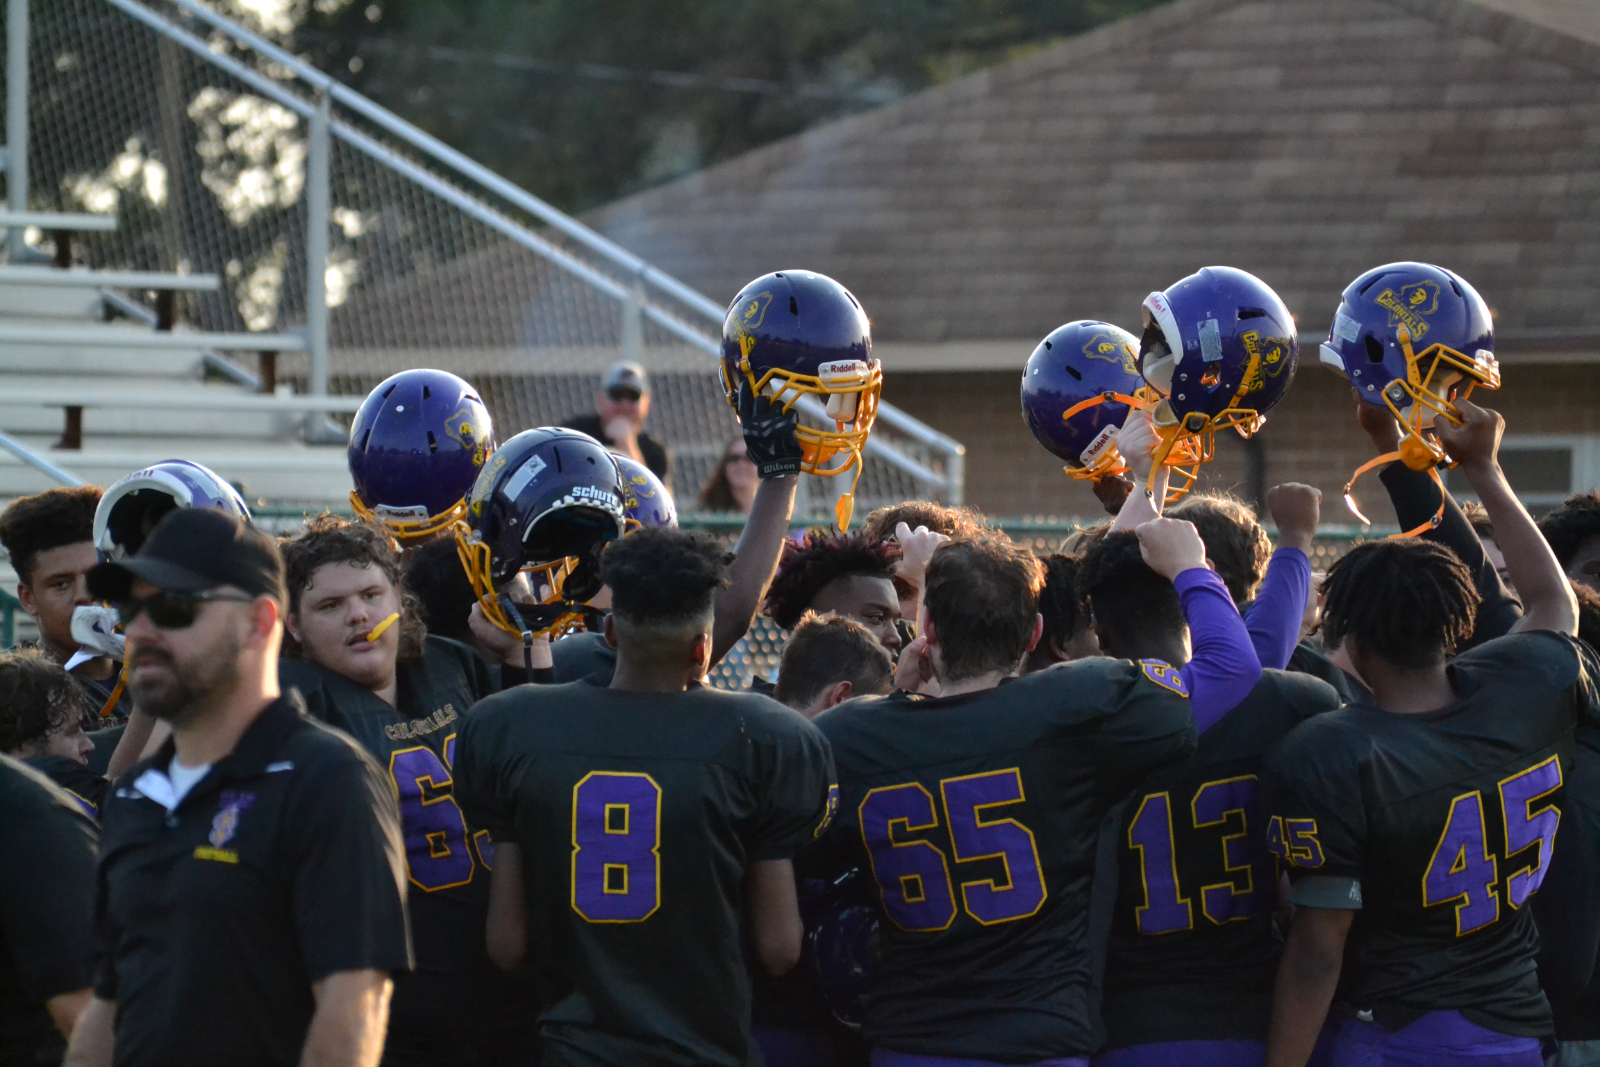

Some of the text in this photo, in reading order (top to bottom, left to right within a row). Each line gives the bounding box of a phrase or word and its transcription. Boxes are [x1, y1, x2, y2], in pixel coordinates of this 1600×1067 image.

[1376, 290, 1428, 339] COLONIALS
[830, 362, 856, 373] Riddell
[763, 462, 796, 474] Wilson
[1087, 433, 1110, 456] Riddell
[572, 485, 618, 507] schutt
[385, 703, 458, 741] COLONIALS
[570, 770, 662, 924] 8
[857, 766, 1048, 933] 65
[1127, 773, 1279, 936] 13
[1265, 814, 1326, 869] 45
[1421, 753, 1563, 938] 45
